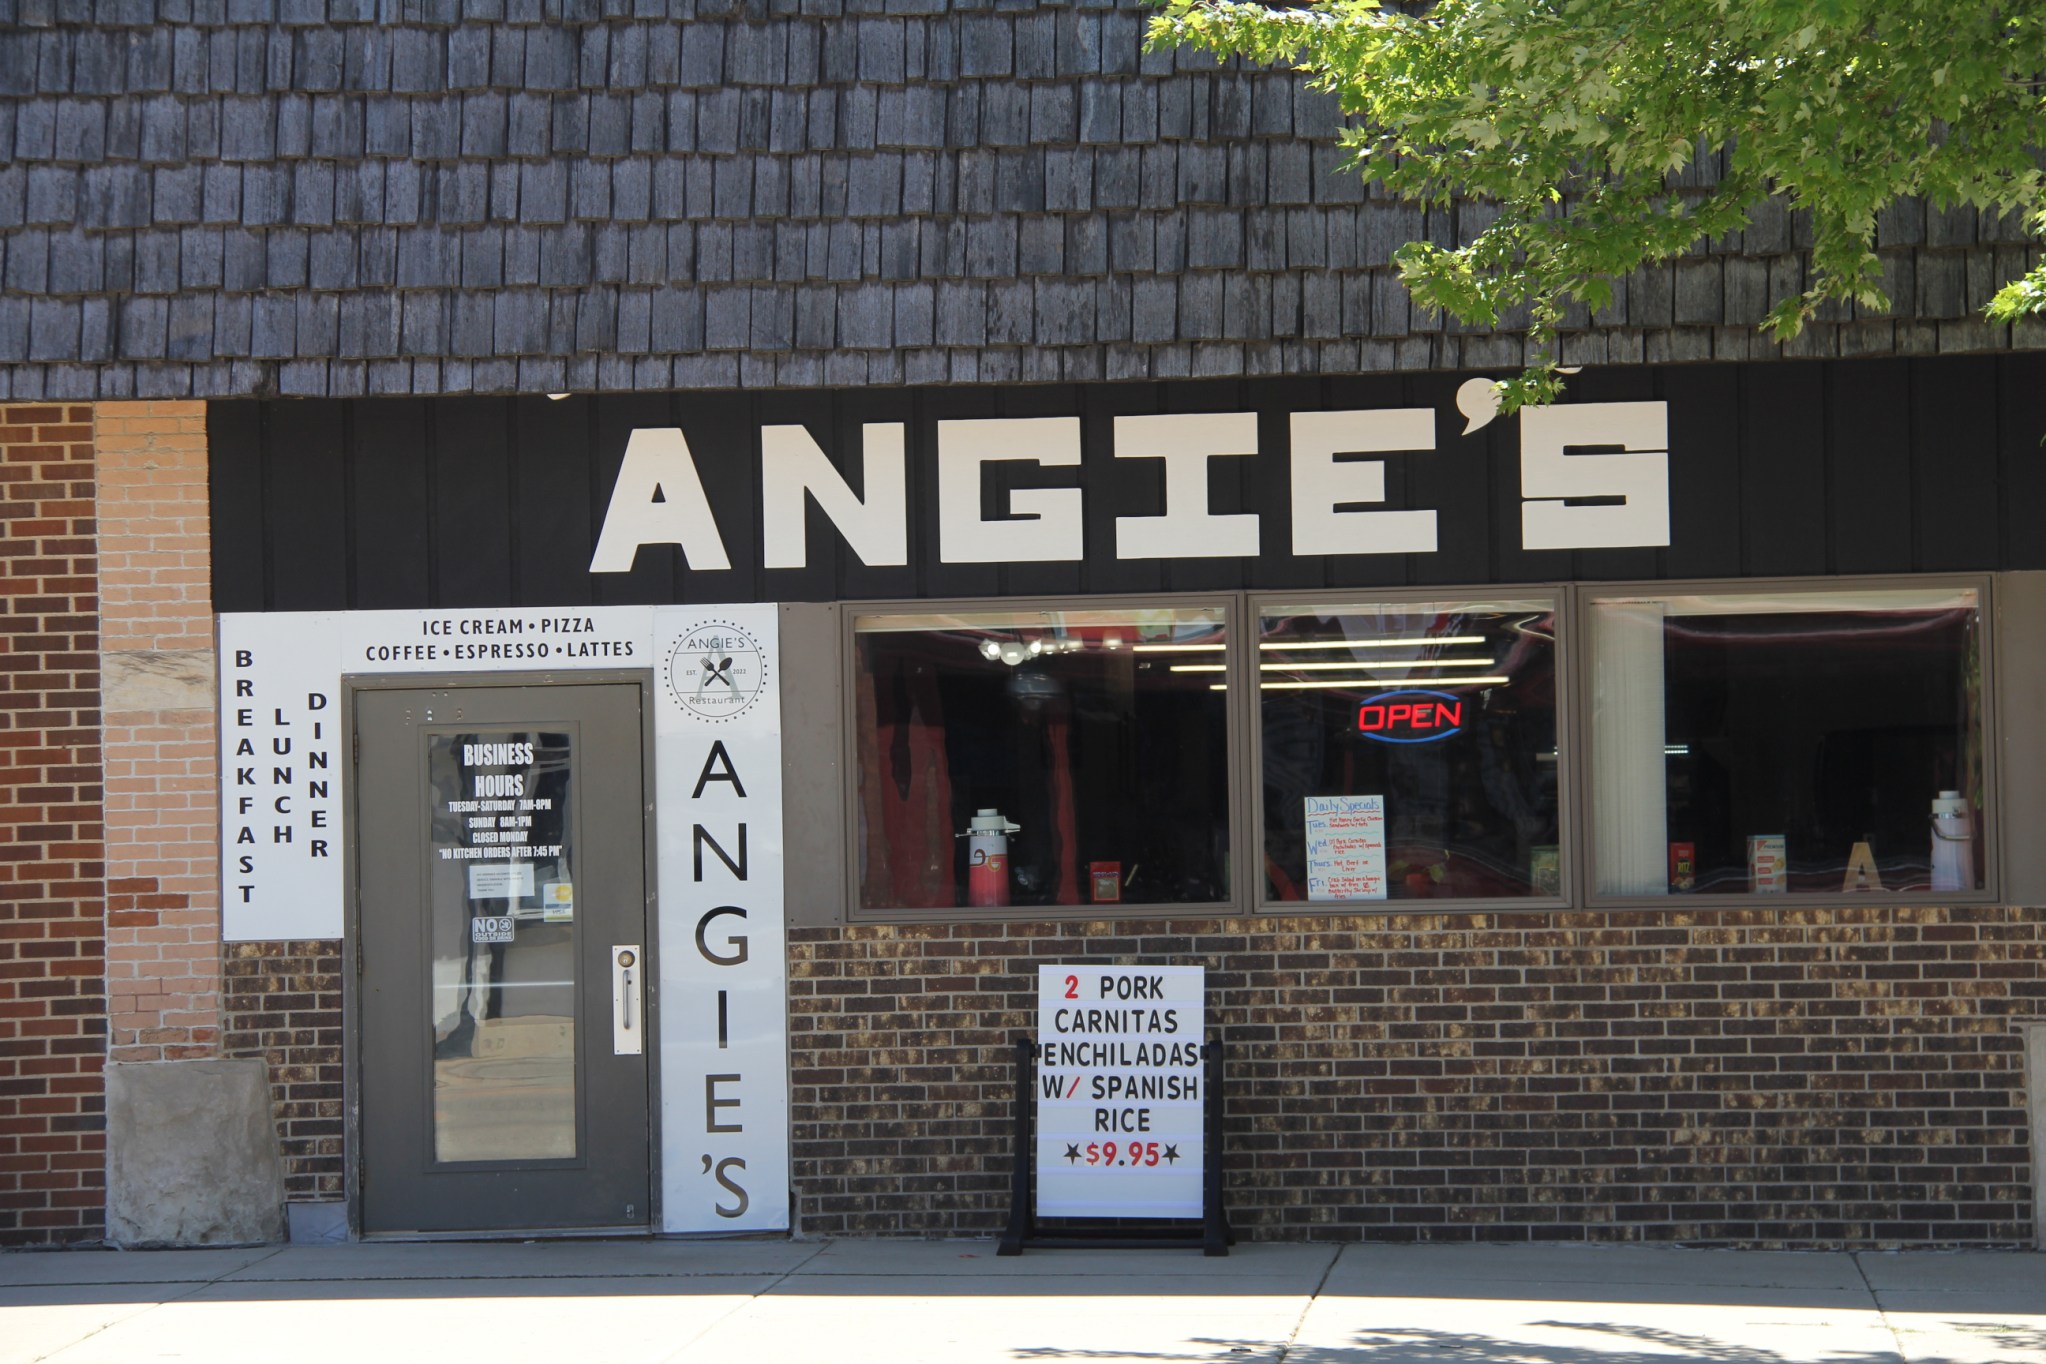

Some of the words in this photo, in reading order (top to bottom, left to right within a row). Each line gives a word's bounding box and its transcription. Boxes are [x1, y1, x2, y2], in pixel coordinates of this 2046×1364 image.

[589, 377, 1670, 573] ANGIE'S
[423, 620, 452, 635] ICE
[460, 619, 523, 635] CREAM
[541, 618, 595, 633] PIZZA
[366, 645, 437, 661] COFFEE
[455, 643, 549, 659] ESPRESSO
[567, 641, 634, 657] LATTES
[687, 637, 745, 649] ANGIE'S
[688, 696, 745, 705] Restaurant
[1358, 702, 1462, 731] OPEN
[463, 743, 534, 766] BUSINESS
[235, 650, 255, 904] BREAKFAST
[273, 708, 293, 844] LUNCH
[308, 693, 329, 858] DINNER
[475, 774, 524, 797] HOURS
[448, 800, 515, 812] TUESDAY-SATURDAY
[519, 799, 552, 810] 7AM-8PM
[1308, 798, 1339, 816] Daily
[1340, 797, 1380, 815] Specials
[469, 817, 496, 828] SUNDAY
[500, 816, 532, 827] 8AM-1PM
[473, 832, 498, 843] CLOSED
[500, 831, 528, 842] MONDAY
[453, 848, 483, 859] KITCHEN
[483, 847, 511, 858] ORDERS
[512, 846, 532, 857] AFTER
[474, 919, 498, 932] NO
[691, 740, 750, 1219] ANGIE'S
[1064, 975, 1079, 999] 2
[1100, 976, 1164, 1000] PORK
[1054, 1009, 1178, 1034] CARNITAS
[1044, 1042, 1198, 1067] ENCHILADAS
[1042, 1075, 1080, 1099] W/
[1092, 1075, 1198, 1100] SPANISH
[1095, 1108, 1151, 1132] RICE
[1086, 1141, 1160, 1167] $9.95
